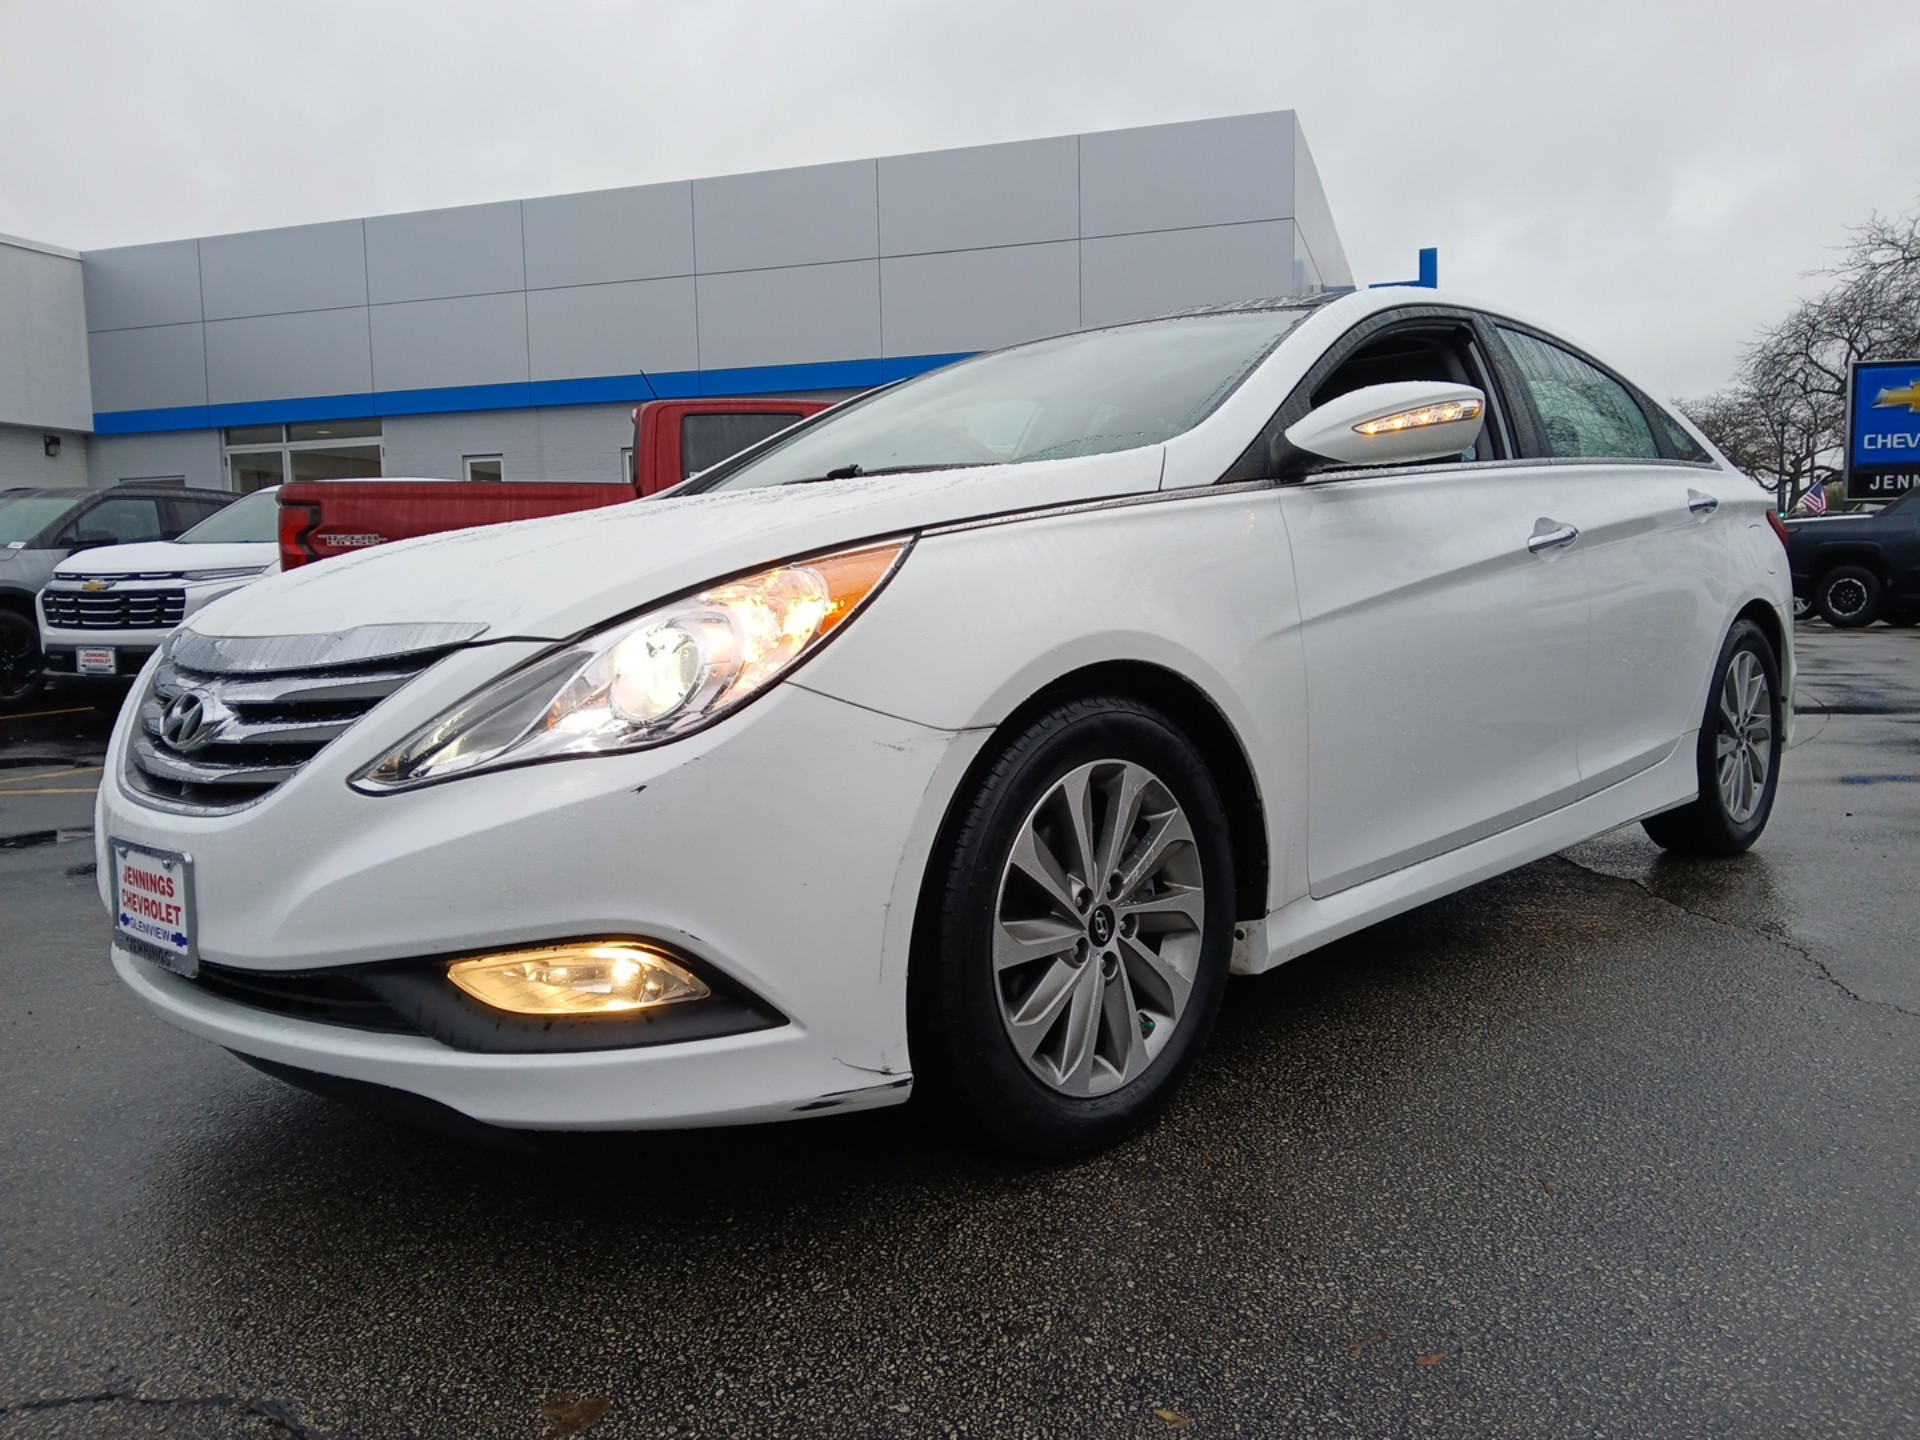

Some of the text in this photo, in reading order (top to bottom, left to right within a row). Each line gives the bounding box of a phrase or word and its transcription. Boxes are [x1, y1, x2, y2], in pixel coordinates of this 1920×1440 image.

[1864, 433, 1920, 449] CHEV
[123, 865, 174, 898] JENNINGS
[122, 888, 181, 926] CHEVROLET
[130, 917, 170, 941] GLENVIEW
